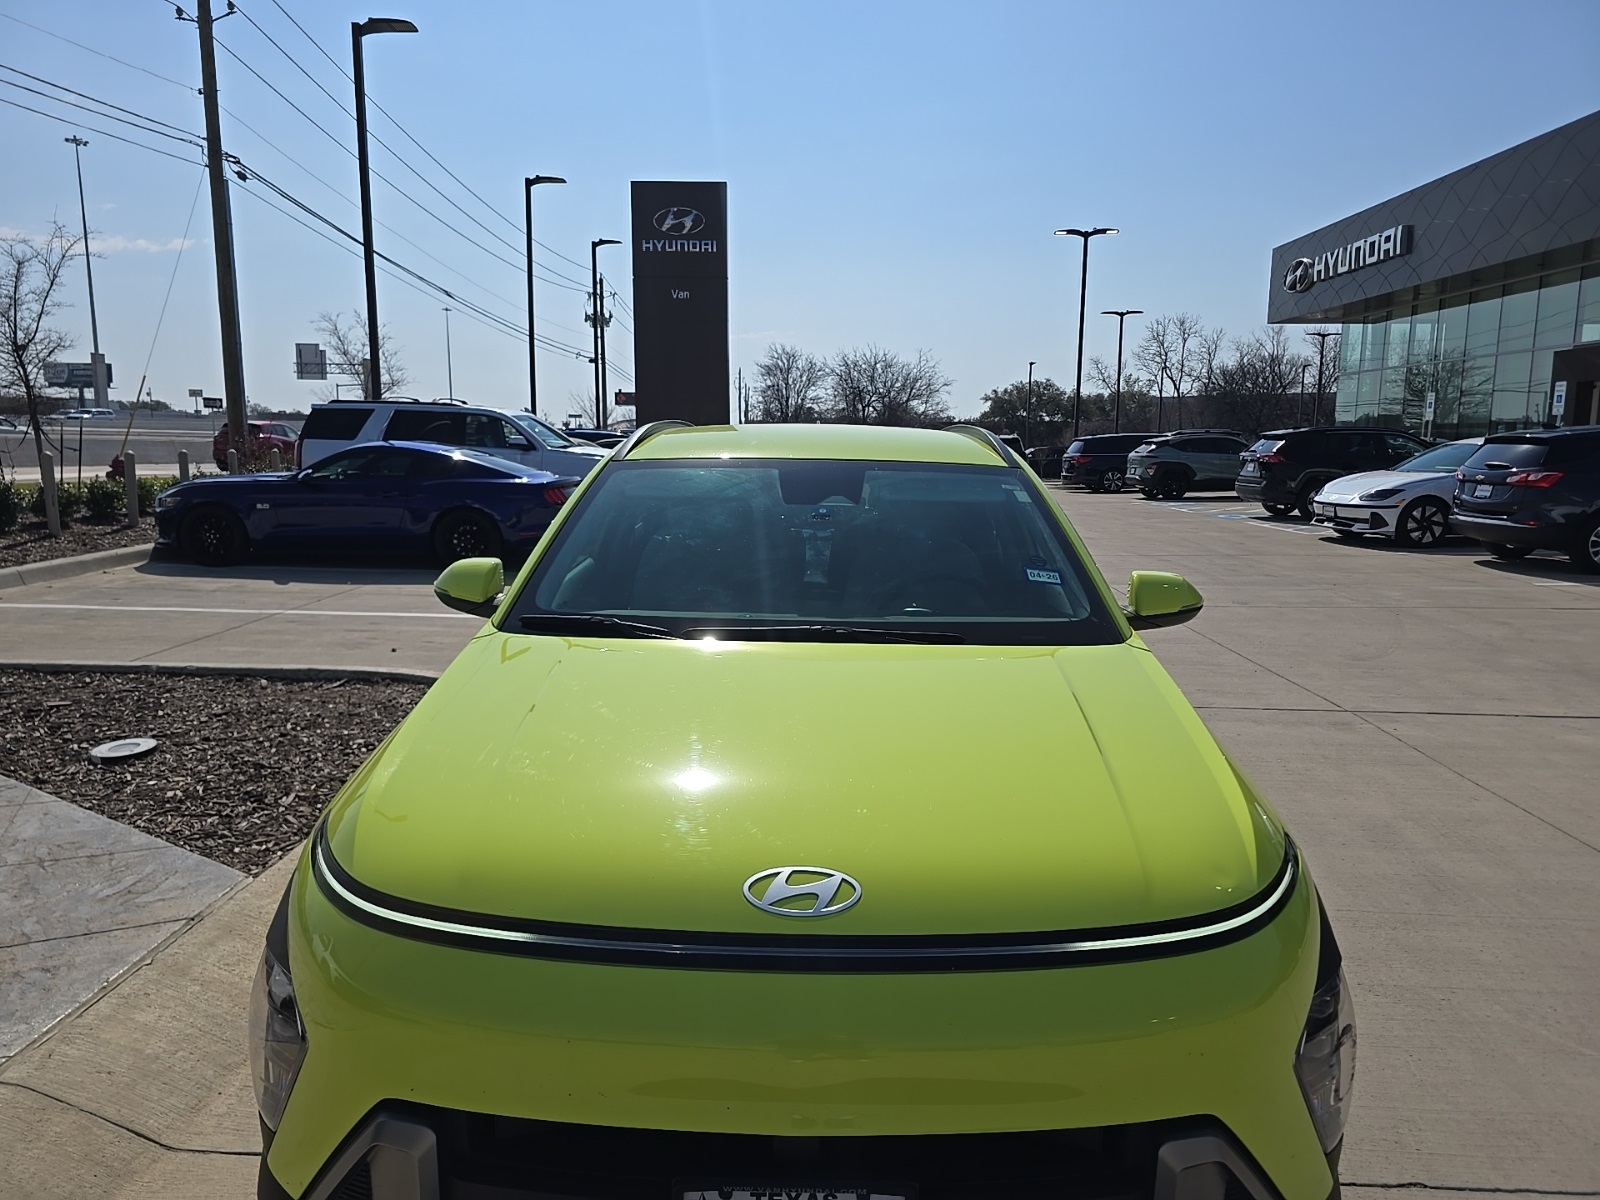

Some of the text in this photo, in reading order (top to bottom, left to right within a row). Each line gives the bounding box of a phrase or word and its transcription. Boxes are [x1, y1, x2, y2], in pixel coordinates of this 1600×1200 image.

[642, 239, 717, 253] HYUNDAI
[1313, 224, 1405, 283] HYUNDAI
[671, 288, 690, 300] Van
